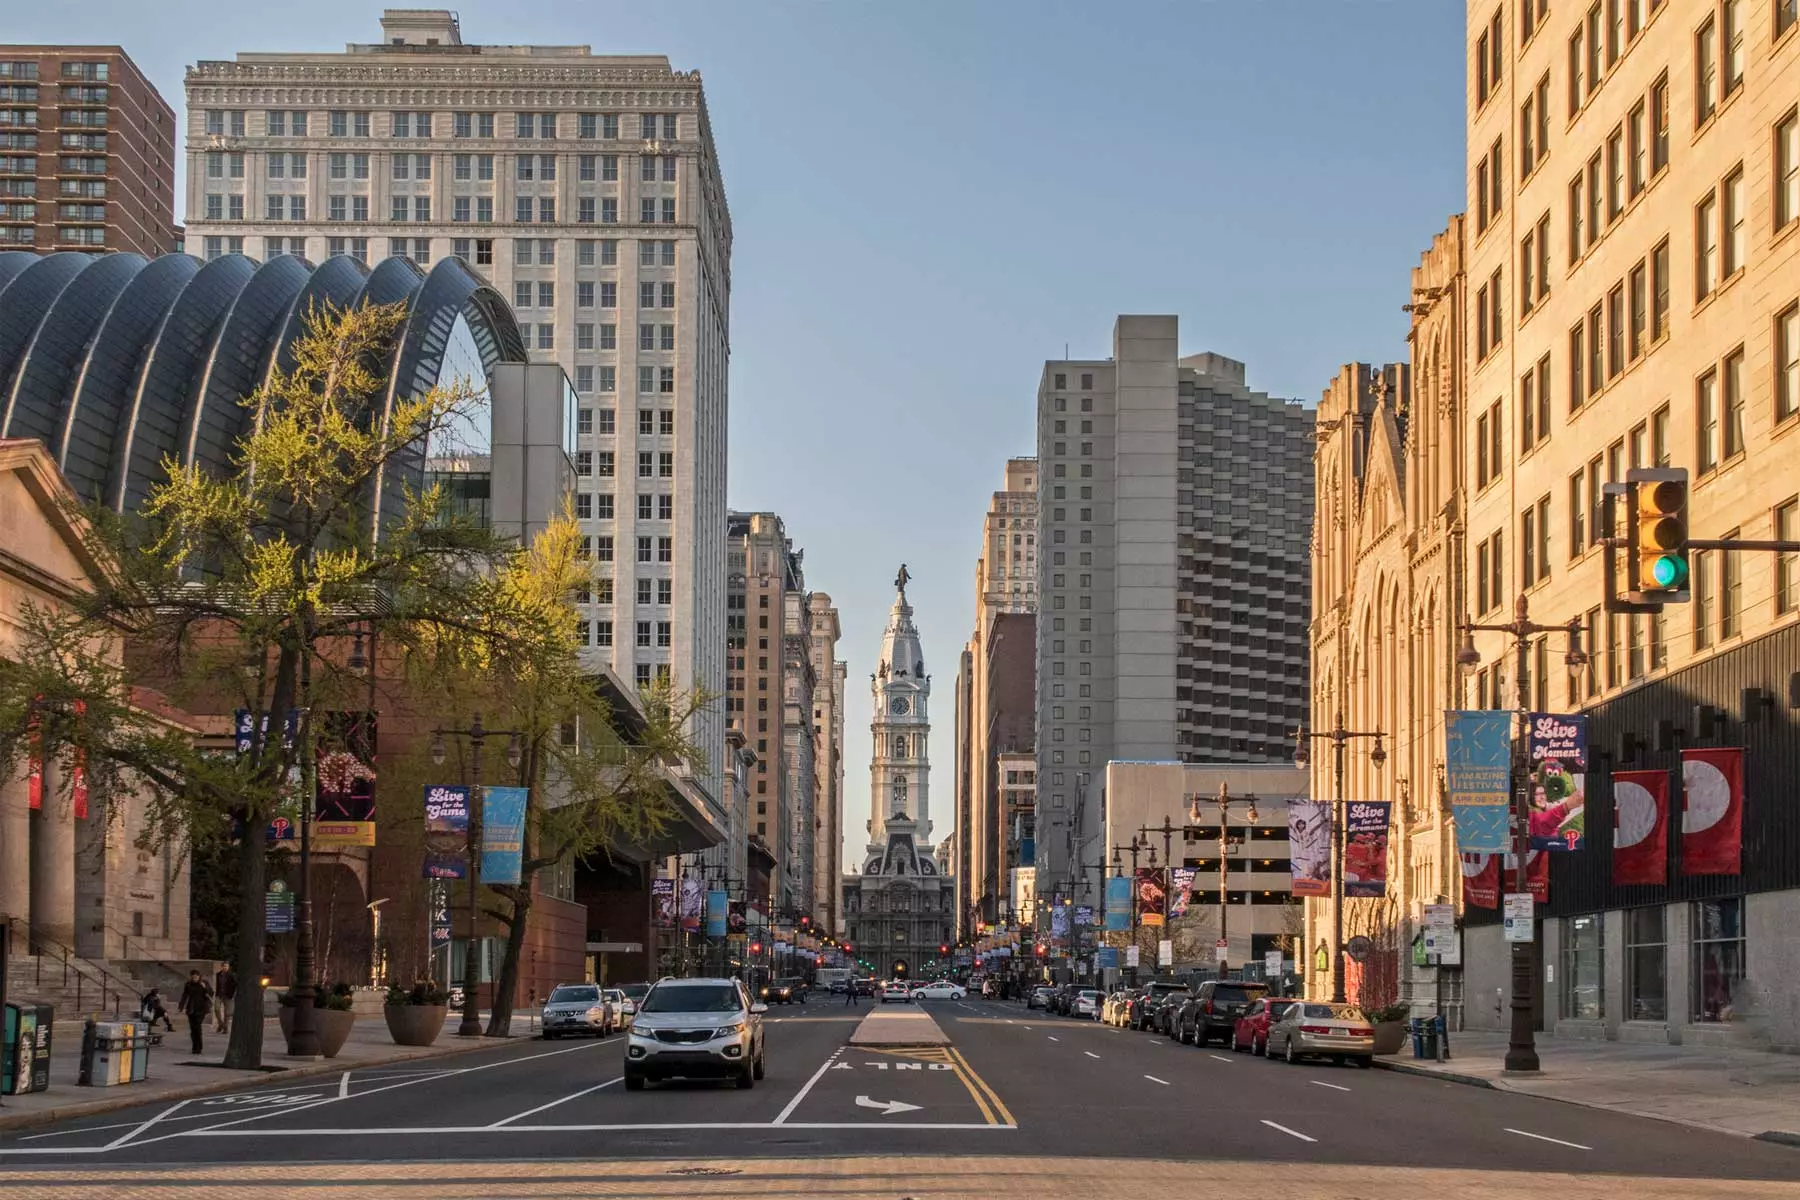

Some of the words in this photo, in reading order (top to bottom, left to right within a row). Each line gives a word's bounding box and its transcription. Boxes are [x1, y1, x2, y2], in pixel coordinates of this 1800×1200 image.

[1534, 717, 1577, 738] Live
[1549, 739, 1561, 748] for
[1562, 739, 1575, 747] the
[1533, 745, 1581, 759] Moment
[1457, 772, 1506, 780] AMAZING
[1457, 781, 1505, 790] FESTIVAL
[428, 788, 464, 802] Live
[426, 805, 466, 820] Game
[1350, 804, 1384, 818] Live
[832, 1062, 953, 1070] ONLY
